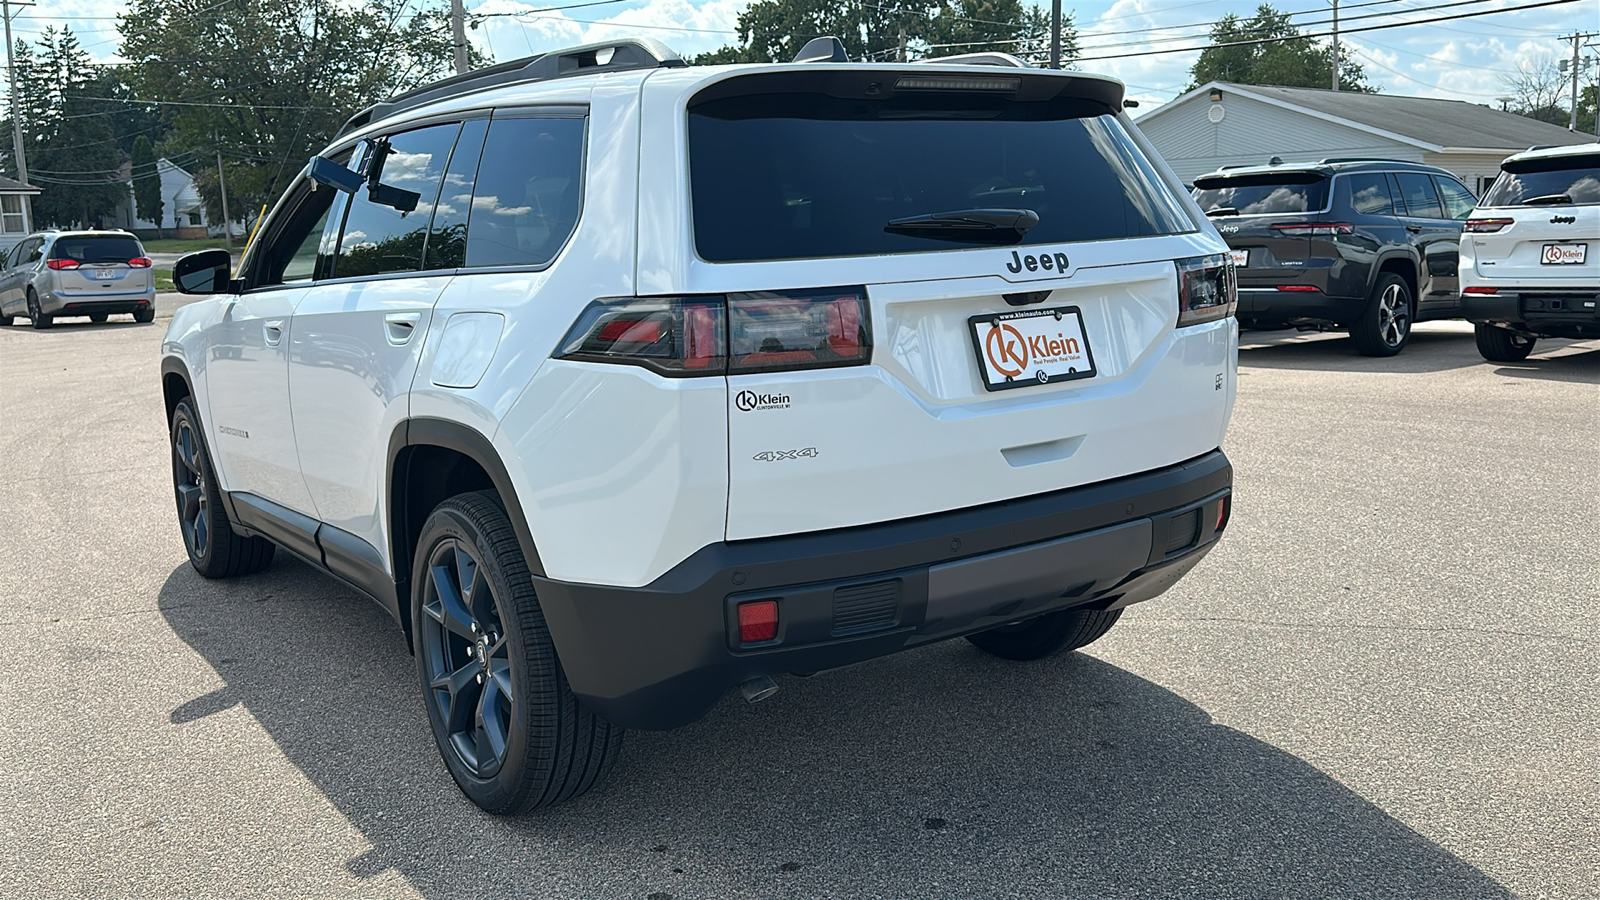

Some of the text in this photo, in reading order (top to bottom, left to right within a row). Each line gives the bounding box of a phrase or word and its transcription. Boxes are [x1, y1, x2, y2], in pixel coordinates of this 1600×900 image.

[1549, 215, 1576, 225] Jeep
[1220, 225, 1239, 233] Jeep
[1562, 250, 1583, 258] Klein
[1006, 250, 1070, 274] Jeep
[999, 308, 1056, 320] www.kleinauto.com
[1027, 332, 1080, 358] Klein
[758, 393, 790, 405] Klein
